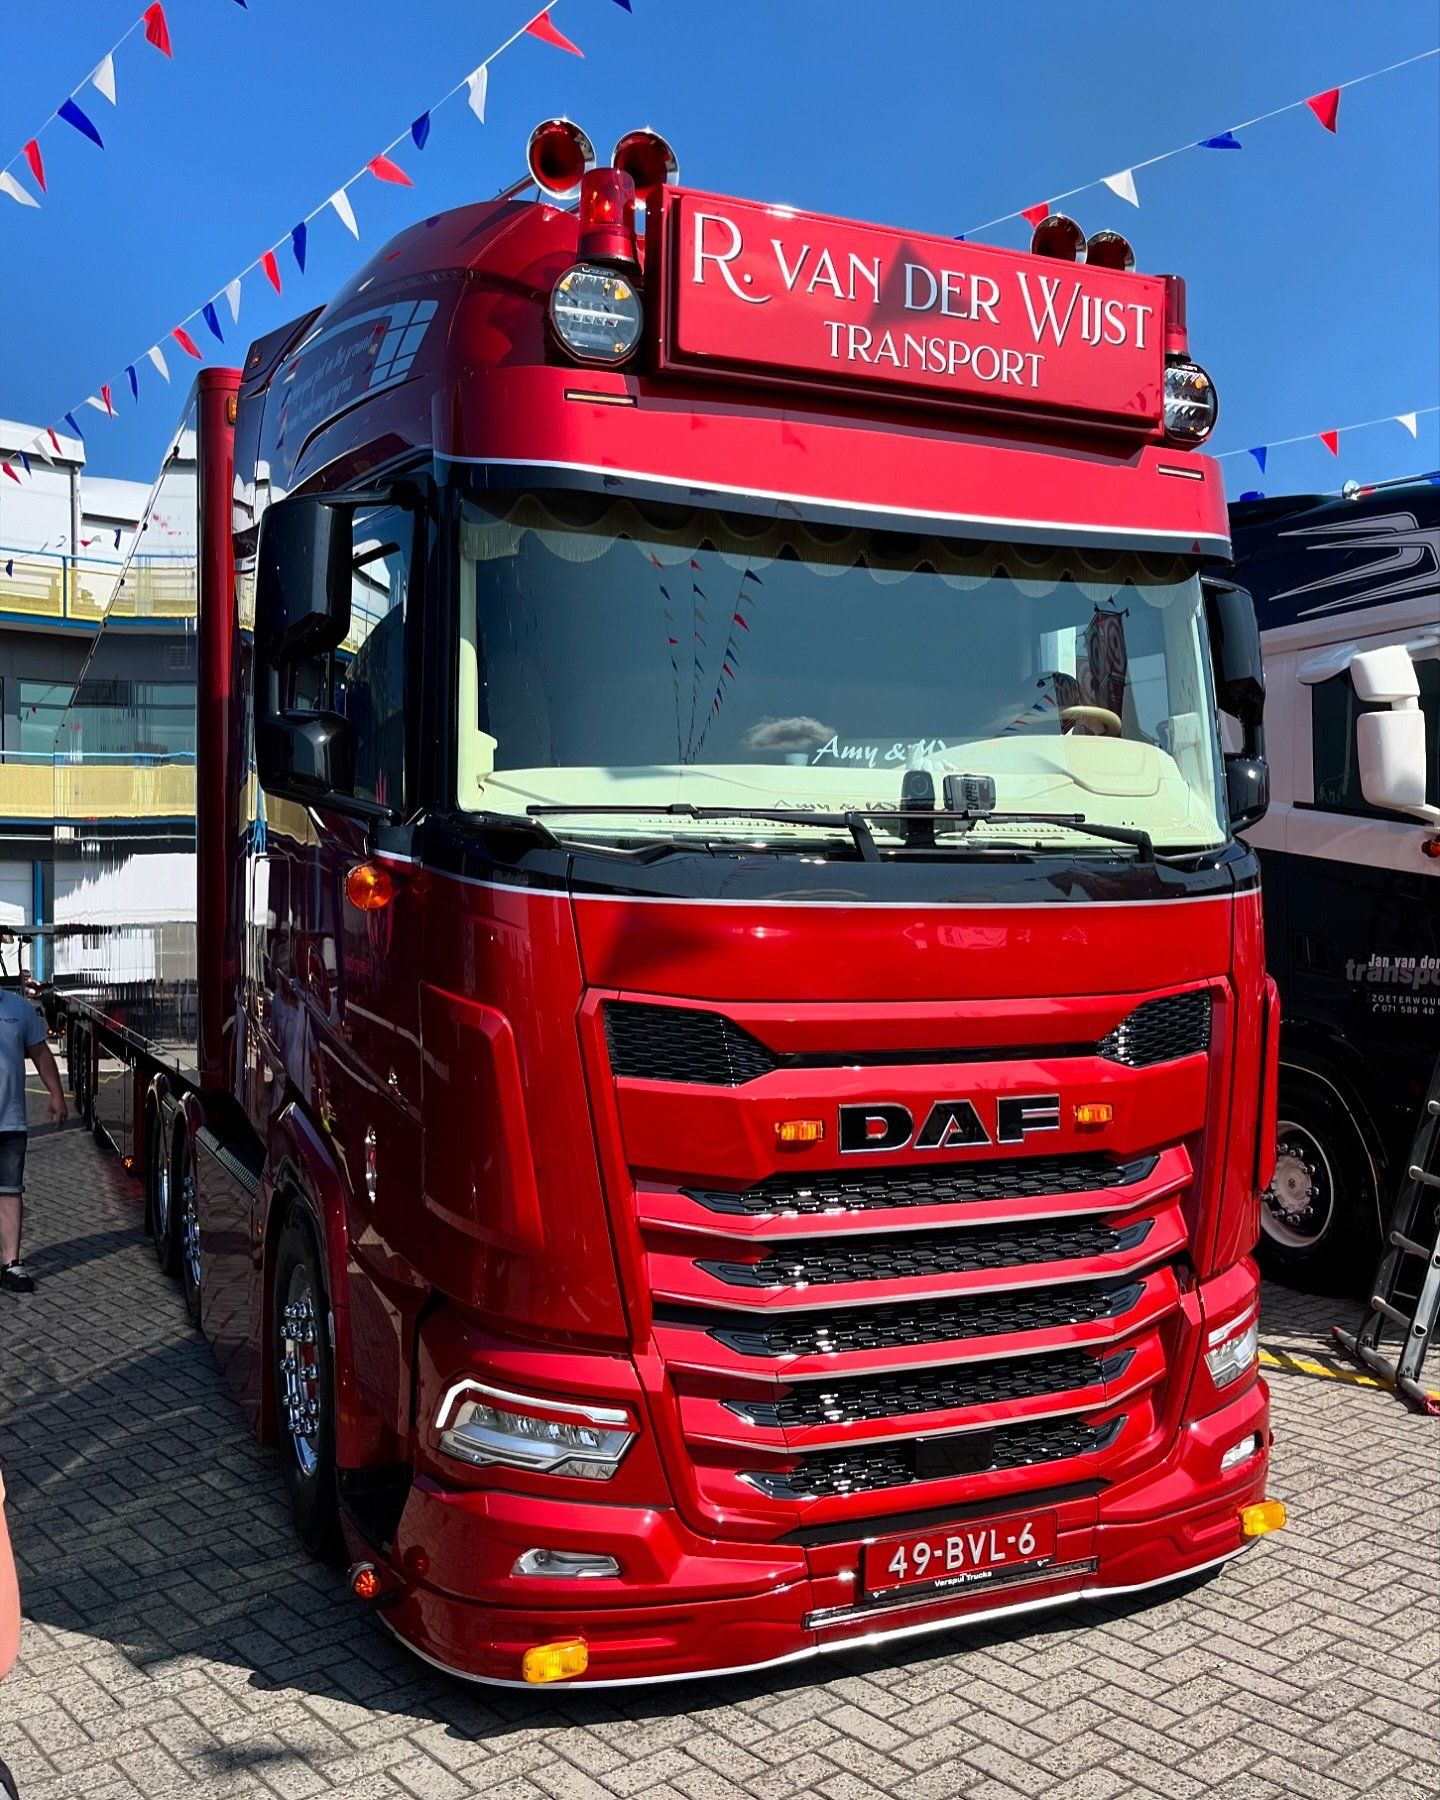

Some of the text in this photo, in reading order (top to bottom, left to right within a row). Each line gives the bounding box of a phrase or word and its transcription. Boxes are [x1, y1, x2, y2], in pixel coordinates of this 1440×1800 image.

[692, 212, 1152, 349] R. VAN DER WIJST
[824, 321, 1045, 387] TRANSPORT
[812, 735, 878, 767] Amy
[884, 743, 906, 761] &
[1368, 953, 1389, 967] Jan
[1395, 957, 1416, 969] van
[838, 1093, 1060, 1154] DAF
[889, 1522, 1036, 1579] 49-BVL-6
[966, 1571, 992, 1581] Trucks
